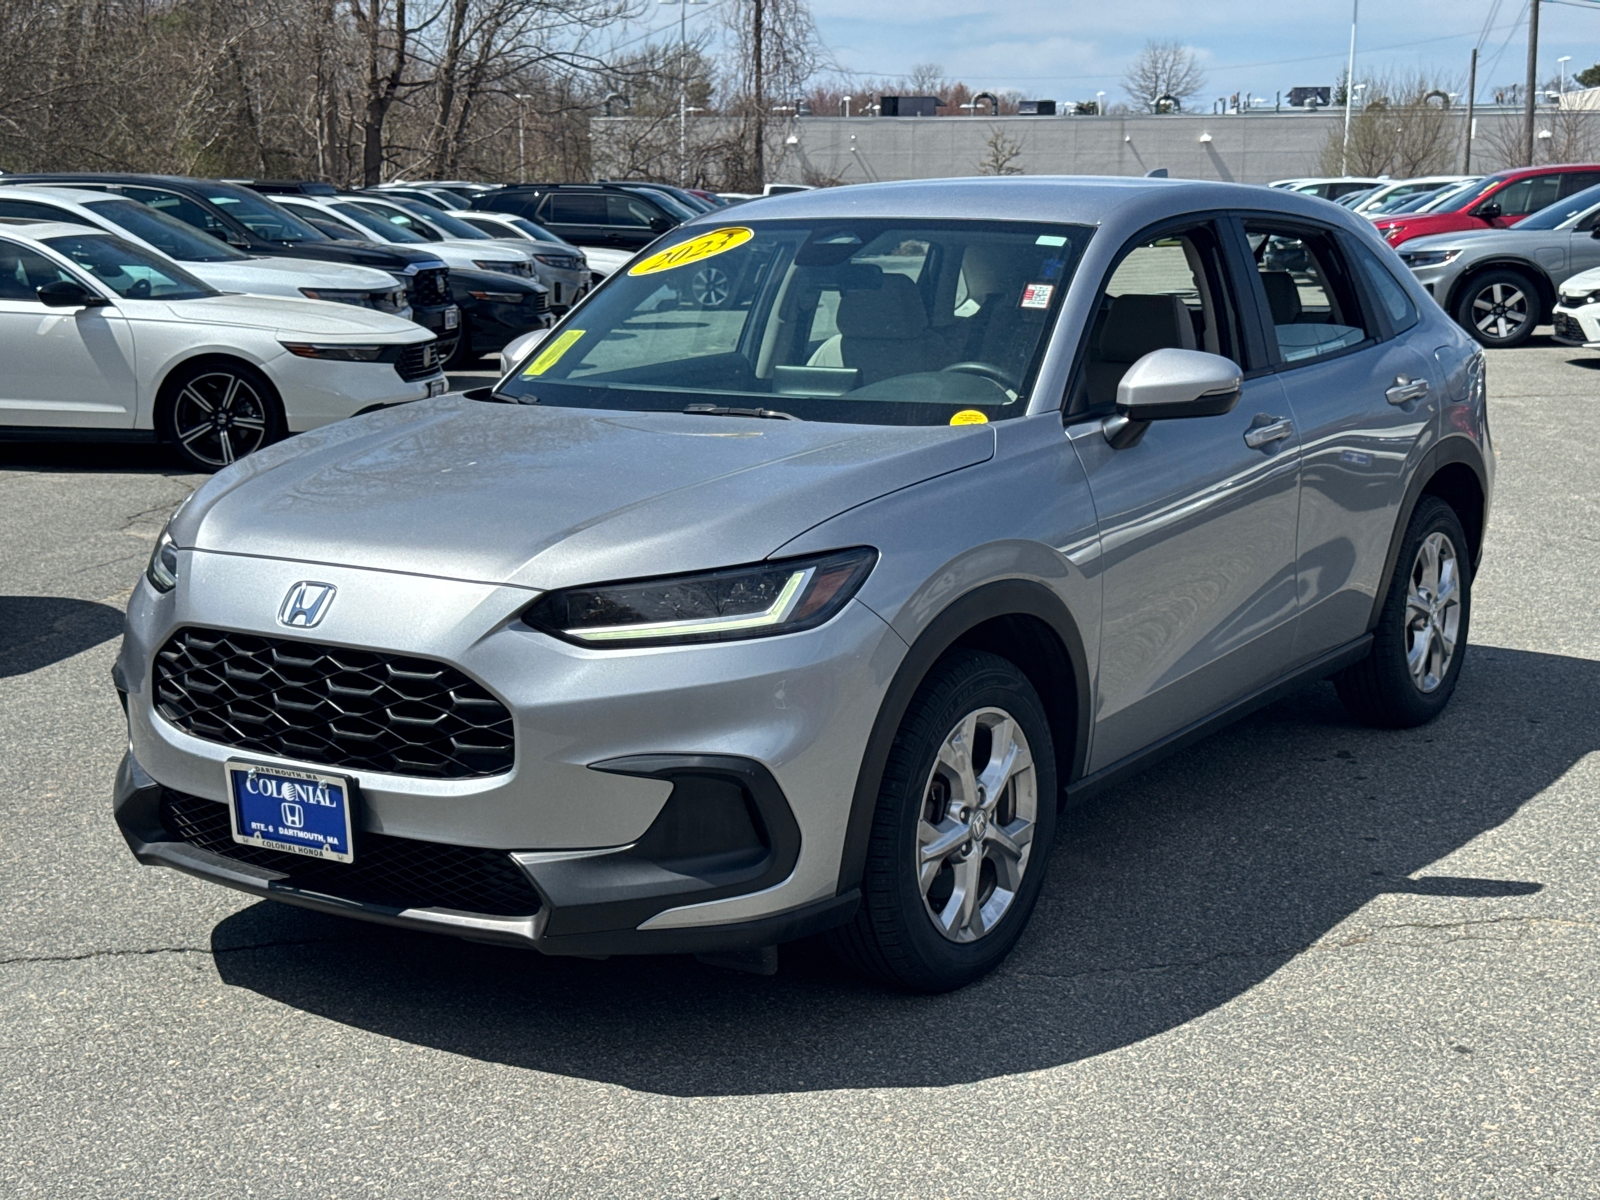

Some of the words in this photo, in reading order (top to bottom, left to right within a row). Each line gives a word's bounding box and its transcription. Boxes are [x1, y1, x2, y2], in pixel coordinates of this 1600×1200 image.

[644, 232, 734, 271] 2023
[246, 777, 336, 807] COLONIAL
[251, 822, 267, 831] RTE.
[269, 825, 274, 833] 6
[278, 827, 326, 843] DARTMOUTH,
[262, 840, 297, 853] COLONIAL
[298, 847, 323, 857] HONDA
